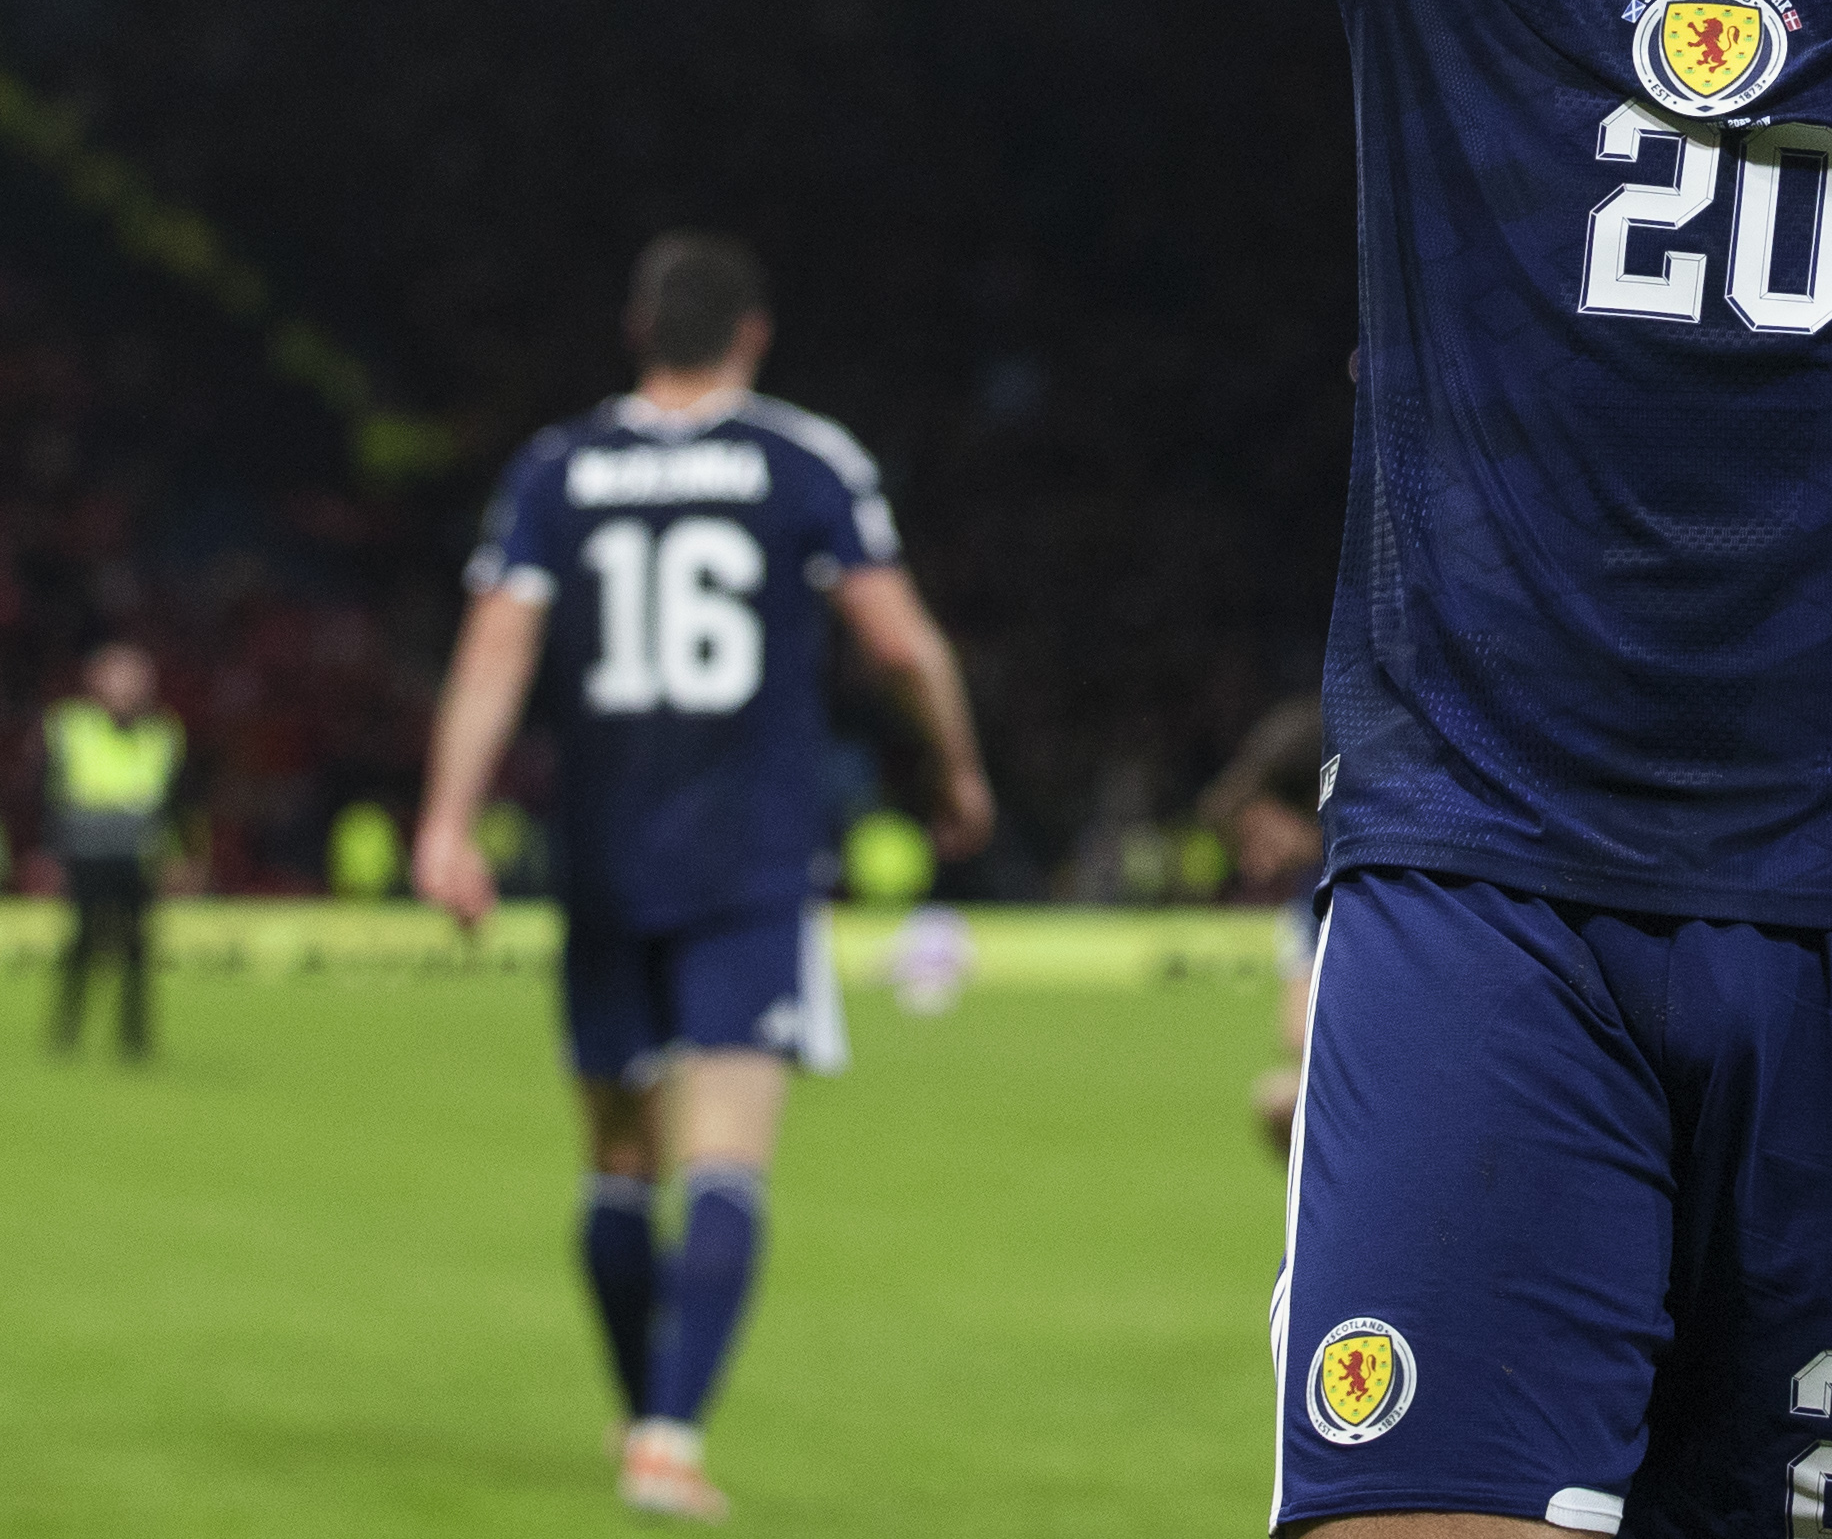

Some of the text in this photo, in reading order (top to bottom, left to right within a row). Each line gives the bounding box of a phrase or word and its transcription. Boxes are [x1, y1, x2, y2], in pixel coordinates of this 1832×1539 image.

[1650, 83, 1672, 102] EST
[1738, 83, 1764, 102] 1873
[582, 517, 766, 715] 16
[1330, 1320, 1385, 1340] SCOTLAND
[1317, 1421, 1331, 1436] EST
[1381, 1410, 1401, 1429] 1873
